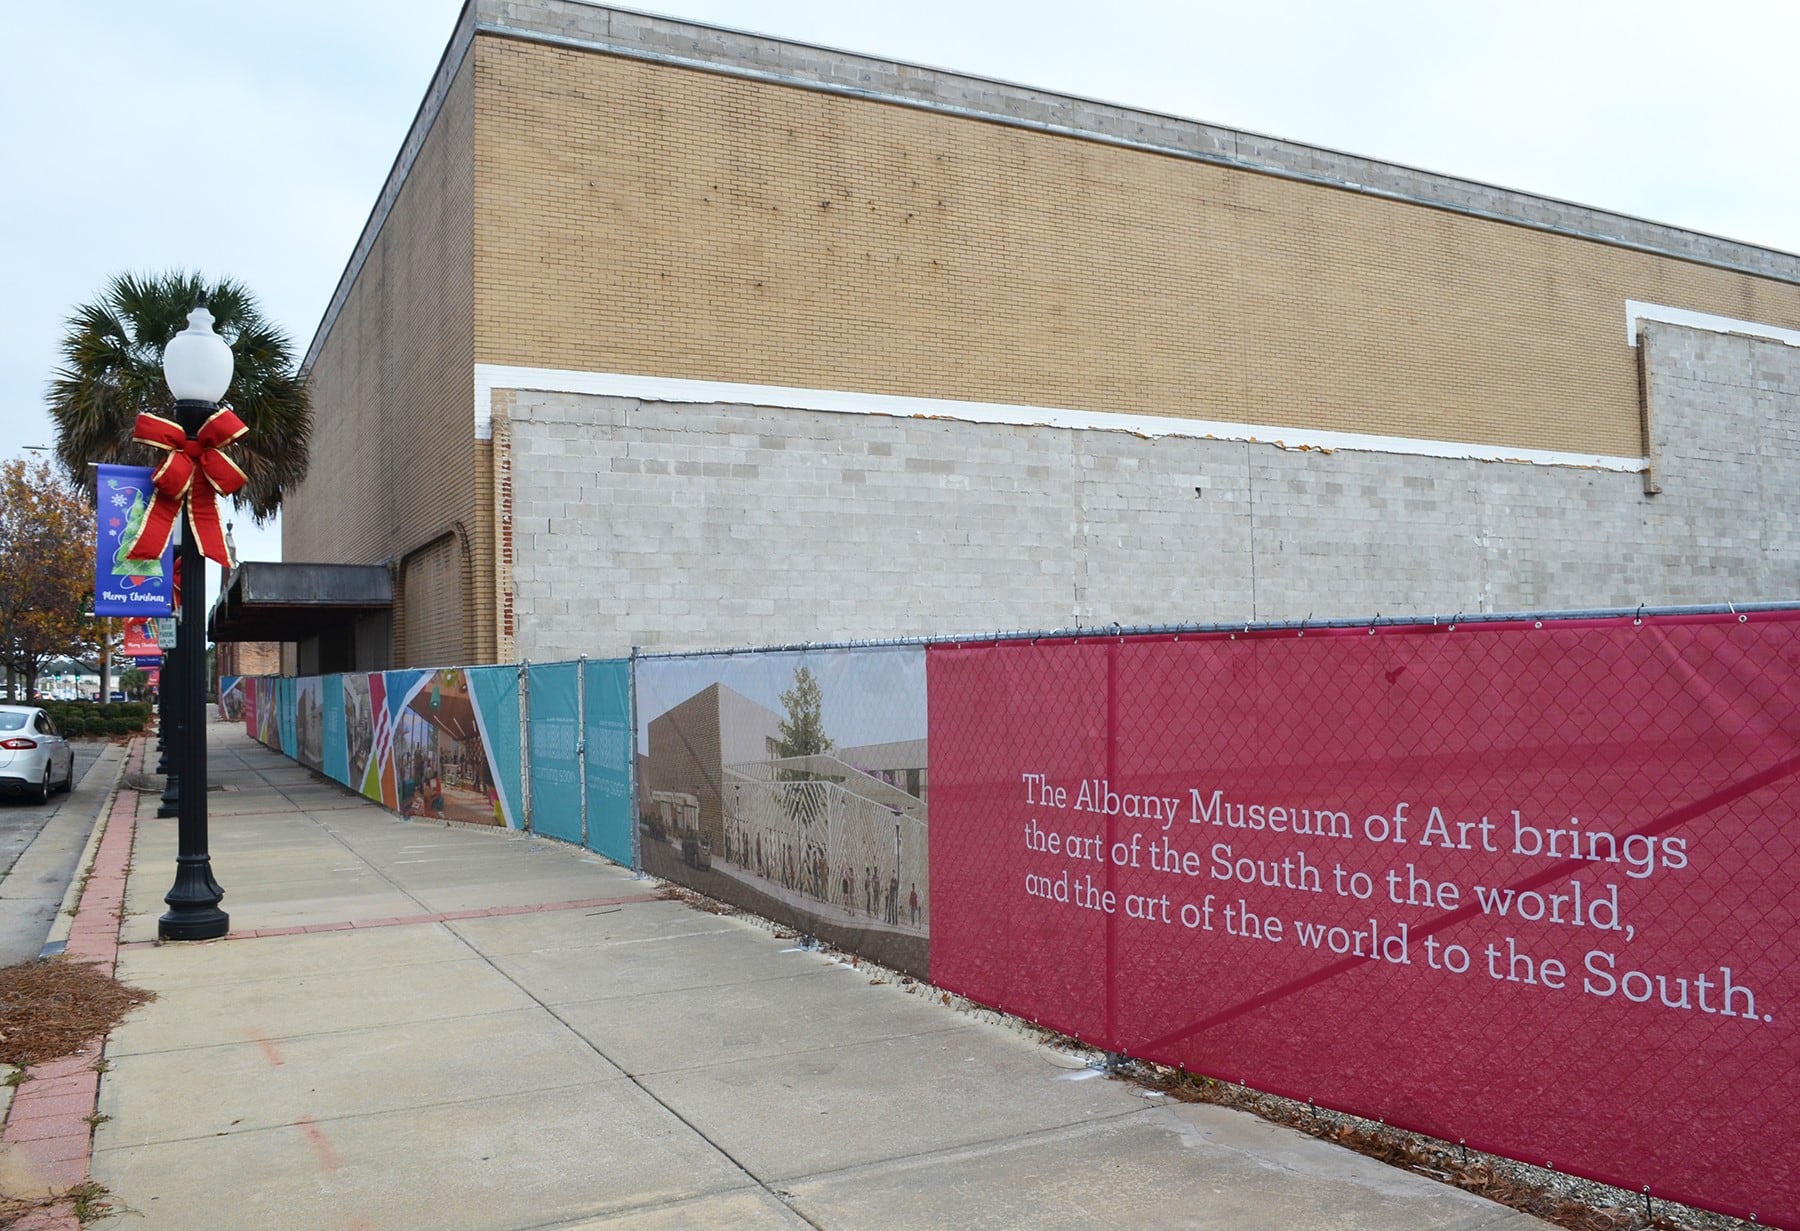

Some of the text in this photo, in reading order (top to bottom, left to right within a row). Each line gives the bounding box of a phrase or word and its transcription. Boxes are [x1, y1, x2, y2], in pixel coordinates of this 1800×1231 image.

[102, 591, 165, 603] Merry Christmas
[1022, 773, 1688, 879] The Albany Museum of Art brings
[1024, 819, 1635, 942] the art of the South to the world,
[1025, 870, 1773, 1023] and the art of the world to the South.
